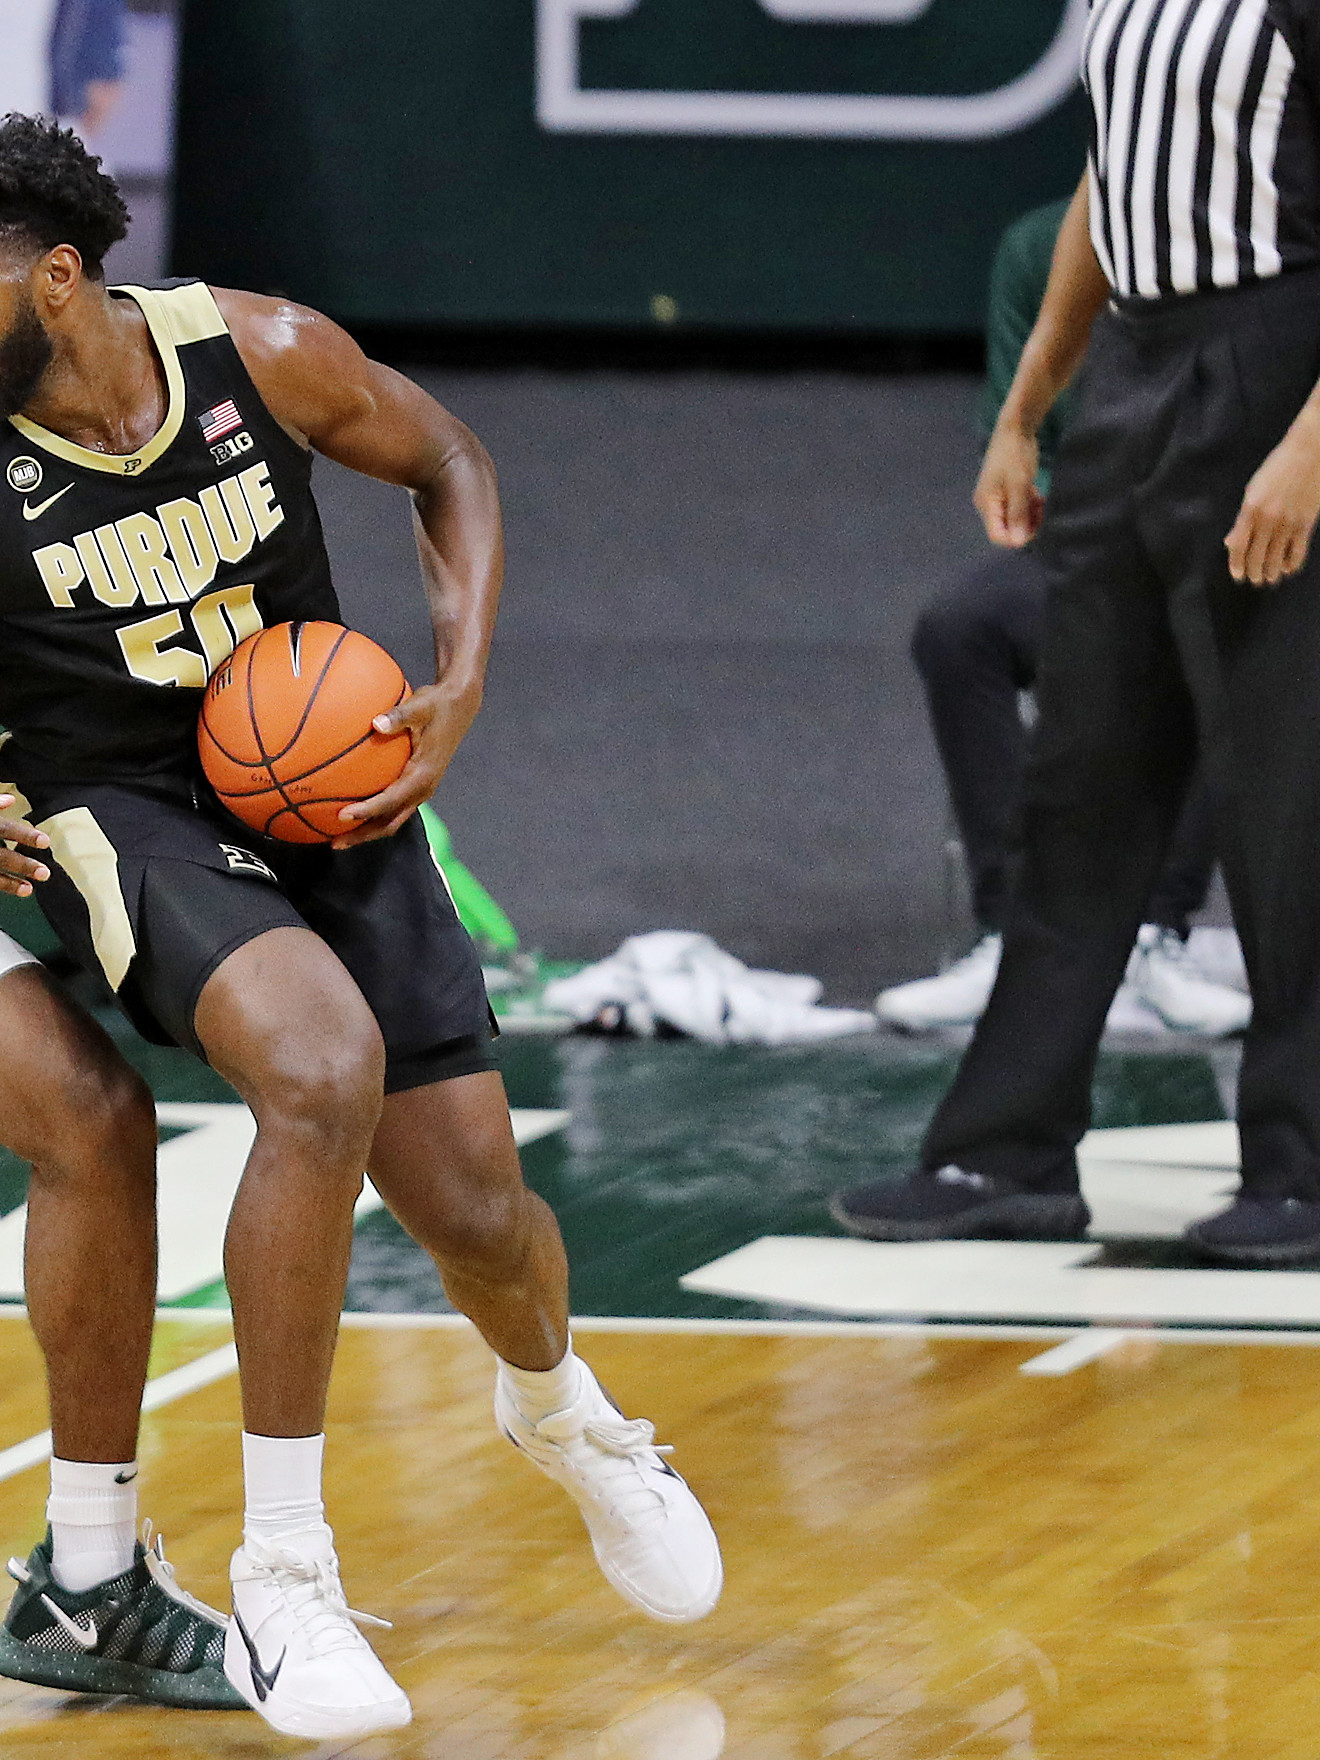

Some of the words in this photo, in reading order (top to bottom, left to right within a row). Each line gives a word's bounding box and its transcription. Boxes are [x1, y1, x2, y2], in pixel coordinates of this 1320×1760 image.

[13, 465, 35, 482] MJB
[32, 460, 284, 608] PURDUE
[115, 584, 263, 687] 50
